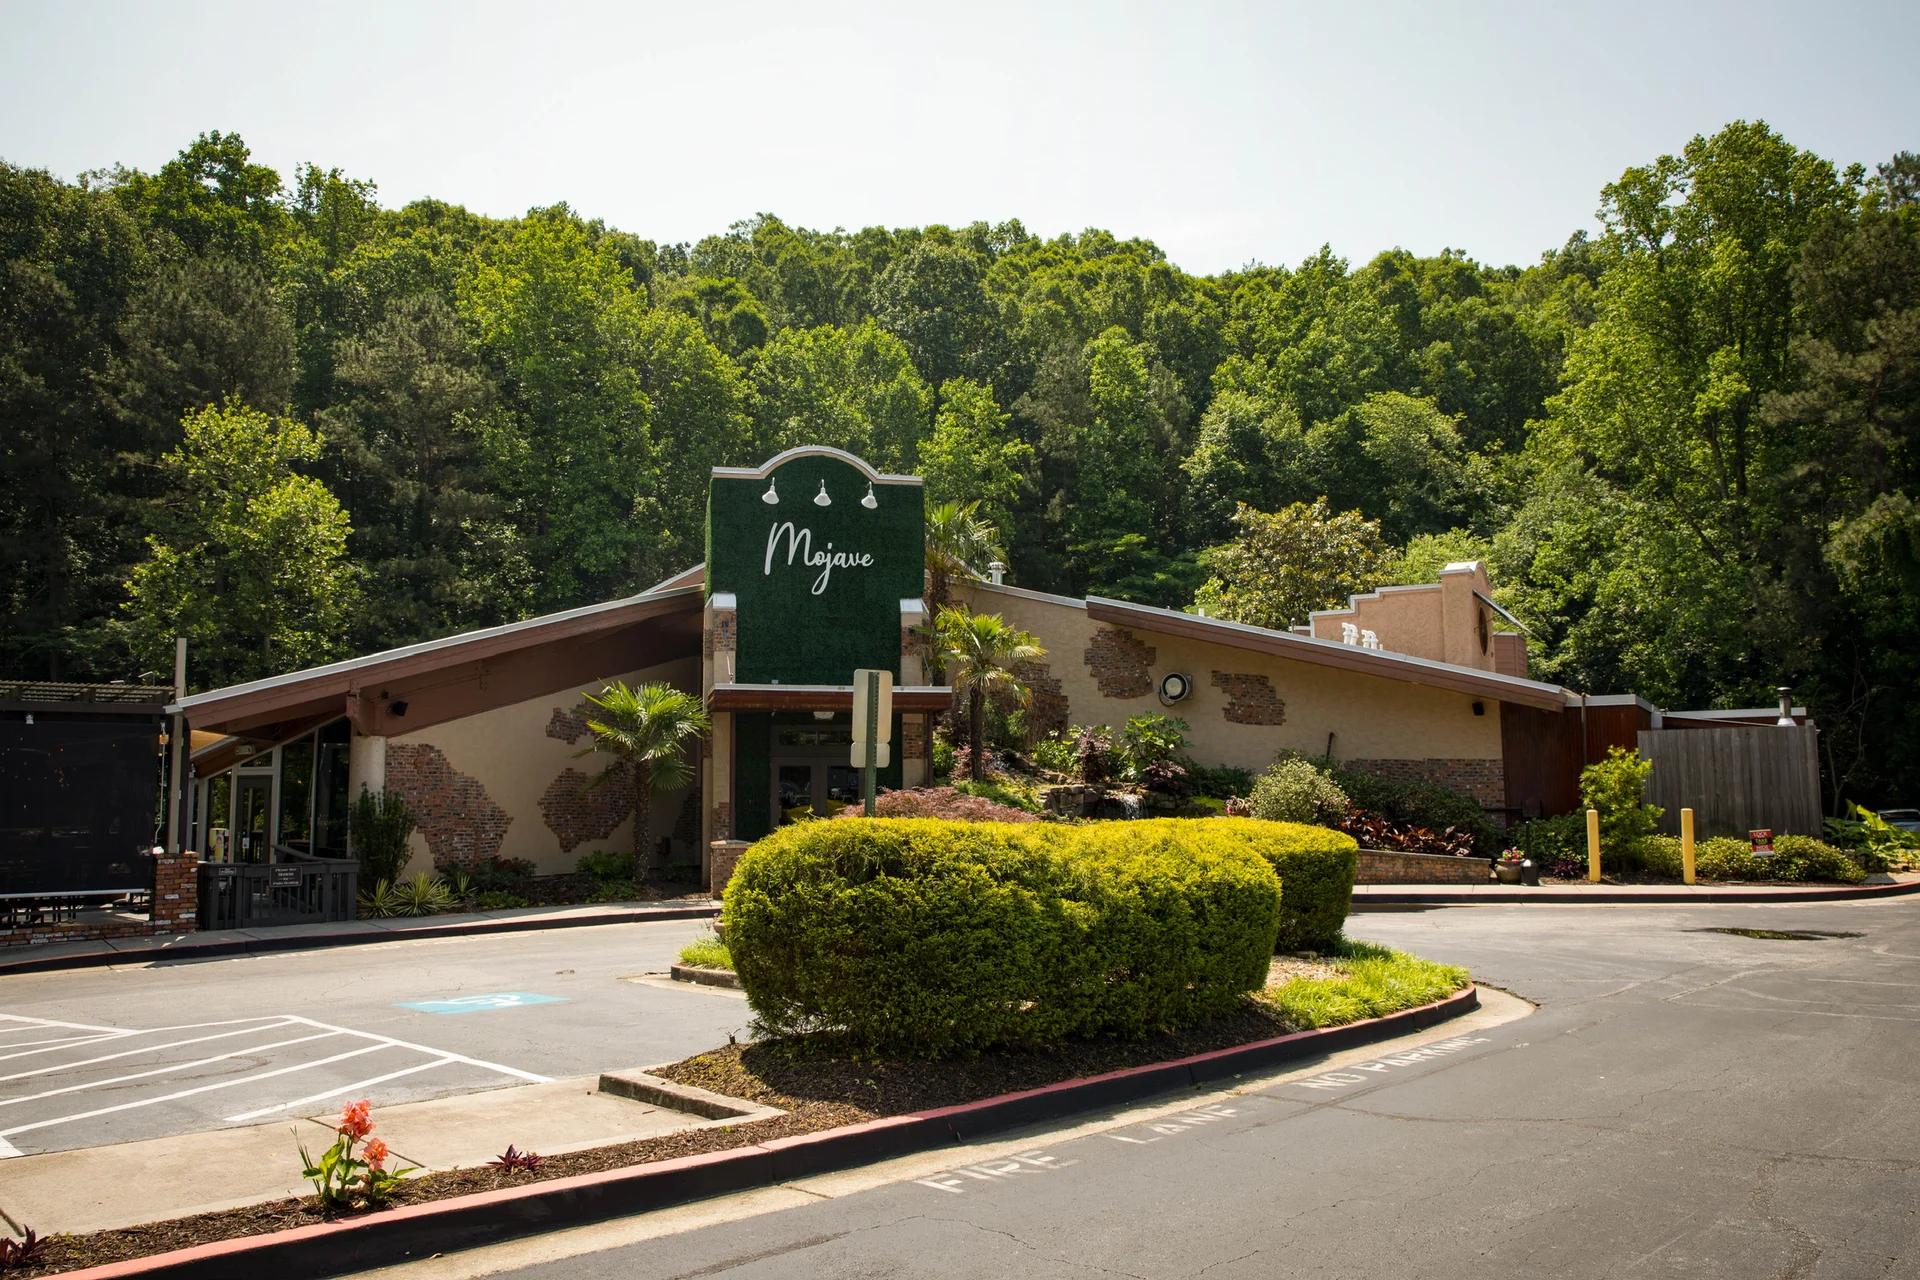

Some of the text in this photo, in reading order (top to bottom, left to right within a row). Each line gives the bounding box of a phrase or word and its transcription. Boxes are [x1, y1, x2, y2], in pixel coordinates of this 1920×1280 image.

[764, 521, 874, 595] Mojave
[912, 1036, 1492, 1194] FIRE LANE NO PARKING
